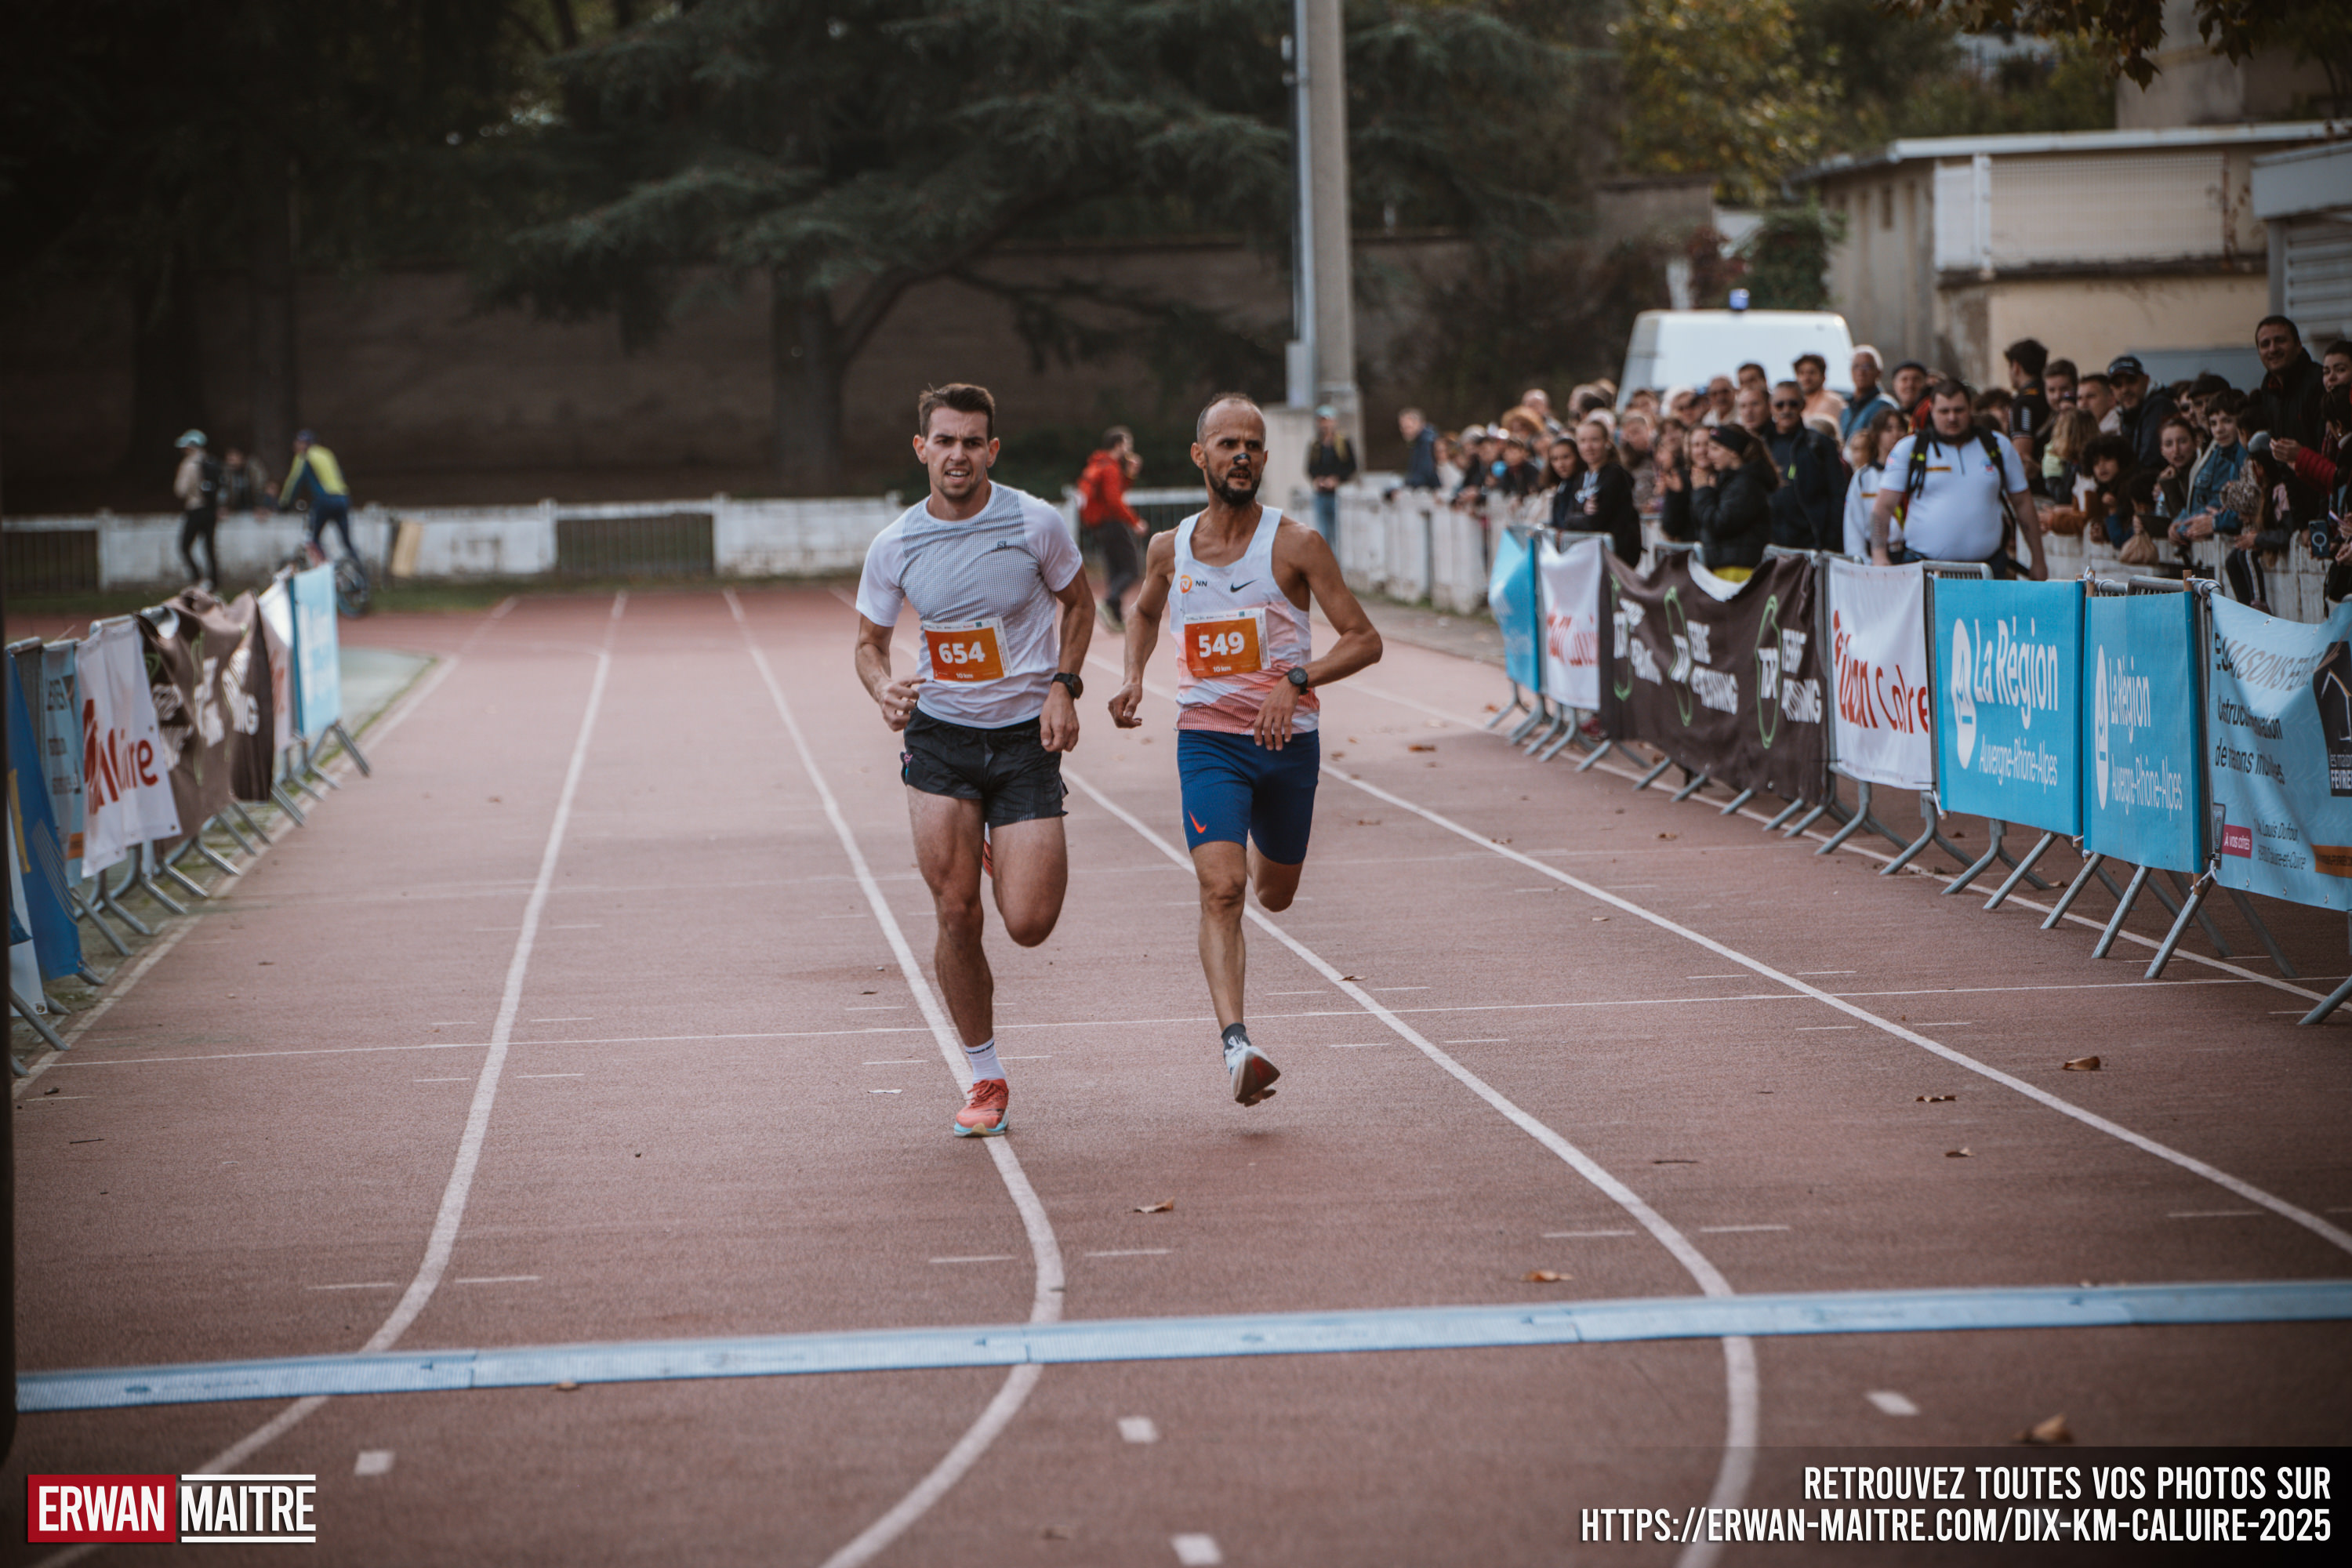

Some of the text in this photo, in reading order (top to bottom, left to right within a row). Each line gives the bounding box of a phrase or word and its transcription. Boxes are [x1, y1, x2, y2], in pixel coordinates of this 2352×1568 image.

[938, 641, 985, 665] 654
[1198, 631, 1245, 658] 549
[1973, 615, 2058, 730] La Région
[2109, 655, 2151, 744] La Région
[1979, 734, 2058, 794] Auvergne-Rhône-Alpes
[2216, 737, 2227, 767] de
[2111, 753, 2183, 822] Auvergne-Rhône-Alpes
[2223, 832, 2230, 848] À
[2229, 835, 2238, 849] vos
